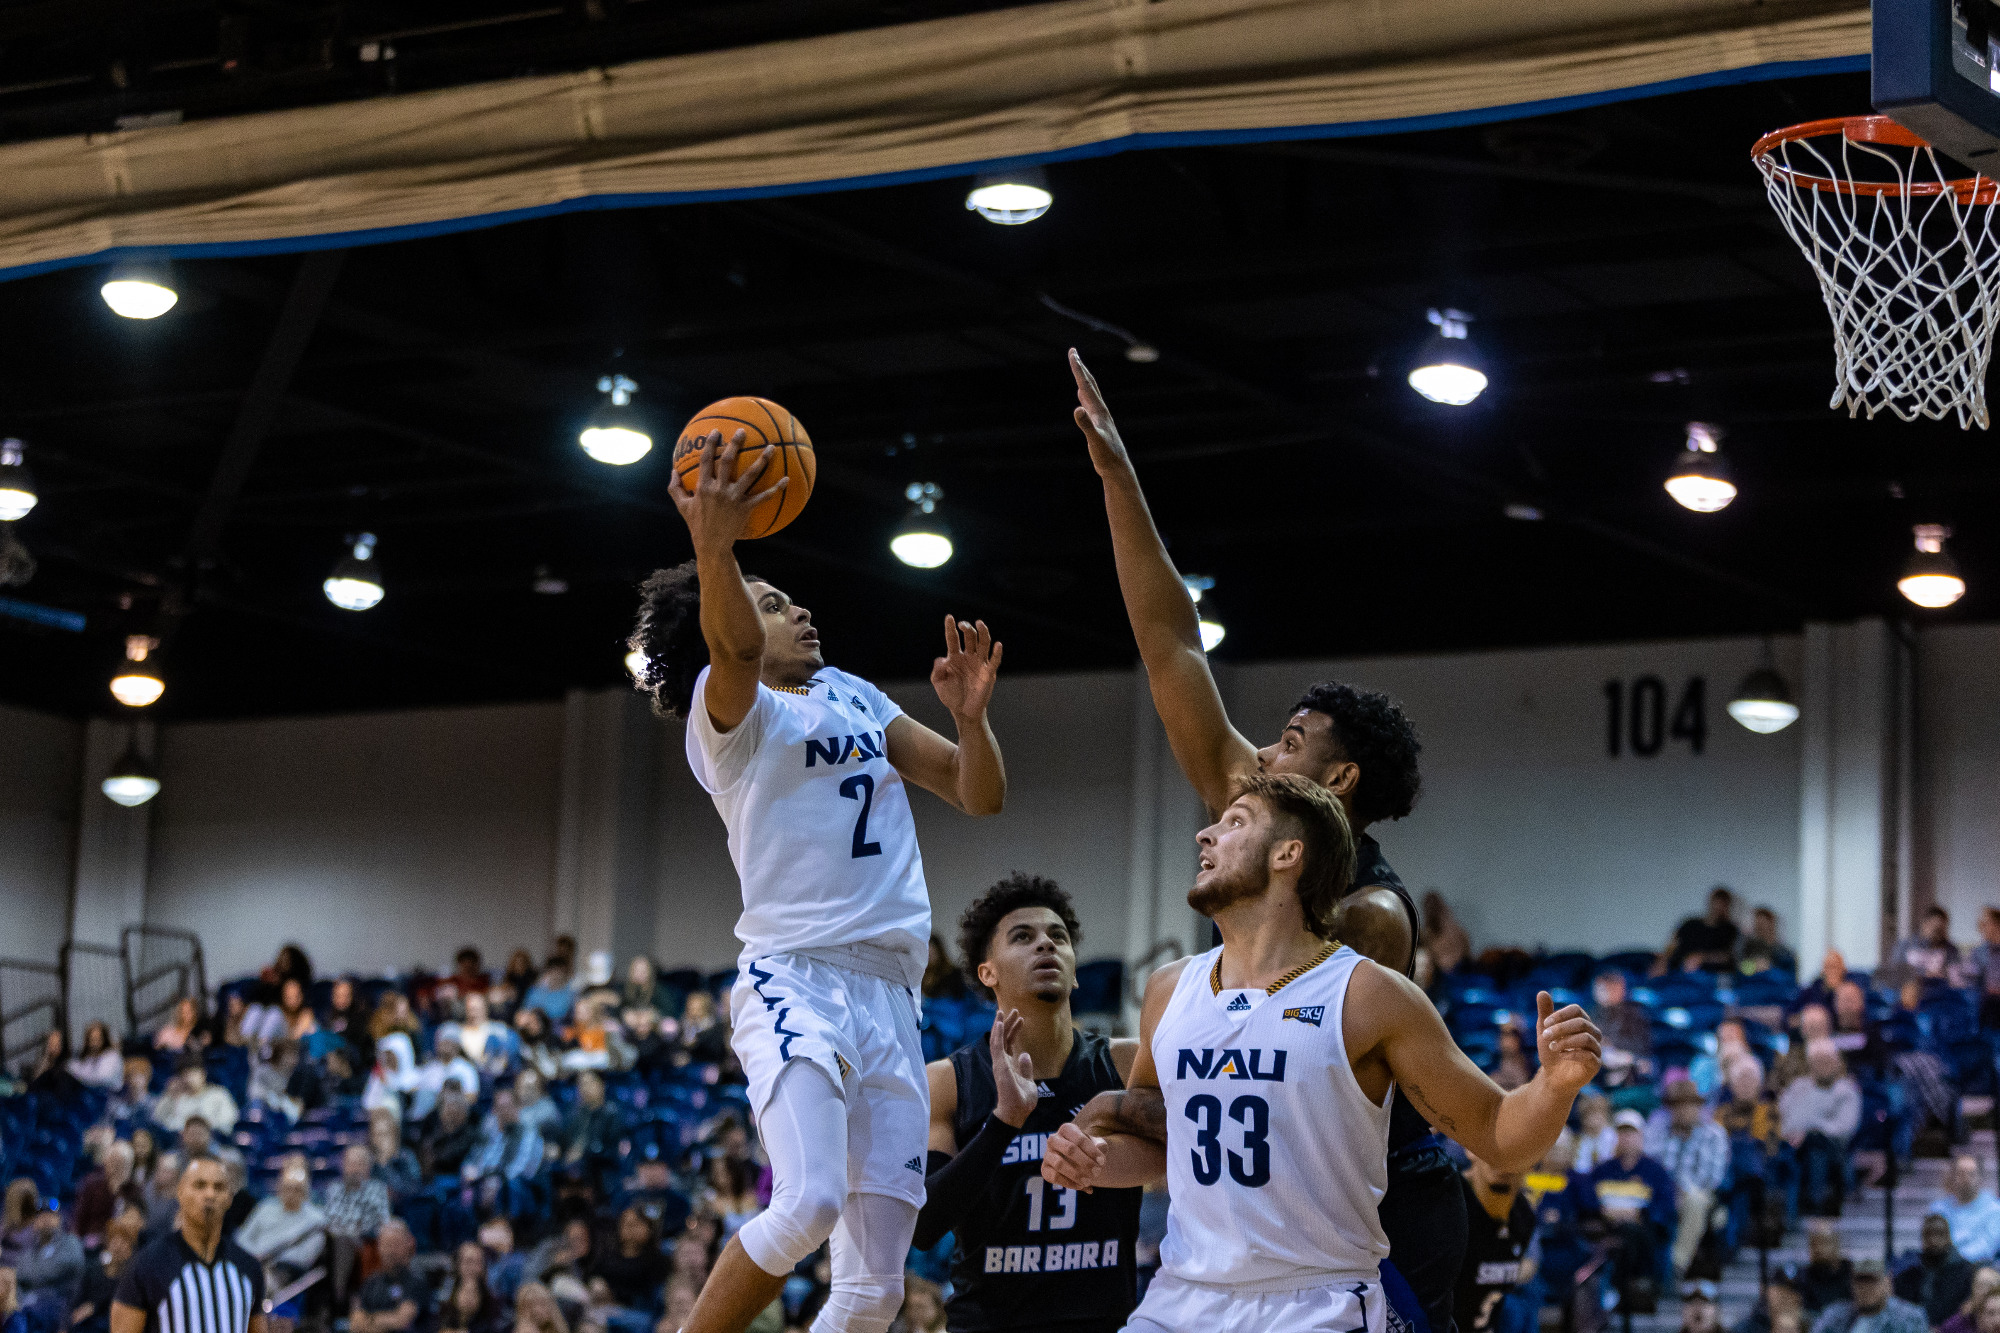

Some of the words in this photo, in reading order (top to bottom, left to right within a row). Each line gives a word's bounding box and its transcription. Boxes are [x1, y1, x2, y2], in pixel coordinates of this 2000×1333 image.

[1604, 675, 1706, 758] 104
[839, 773, 883, 859] 2
[1177, 1048, 1288, 1082] NAU
[1184, 1094, 1271, 1188] 33
[1025, 1175, 1078, 1231] 13
[984, 1239, 1119, 1273] BARBARA
